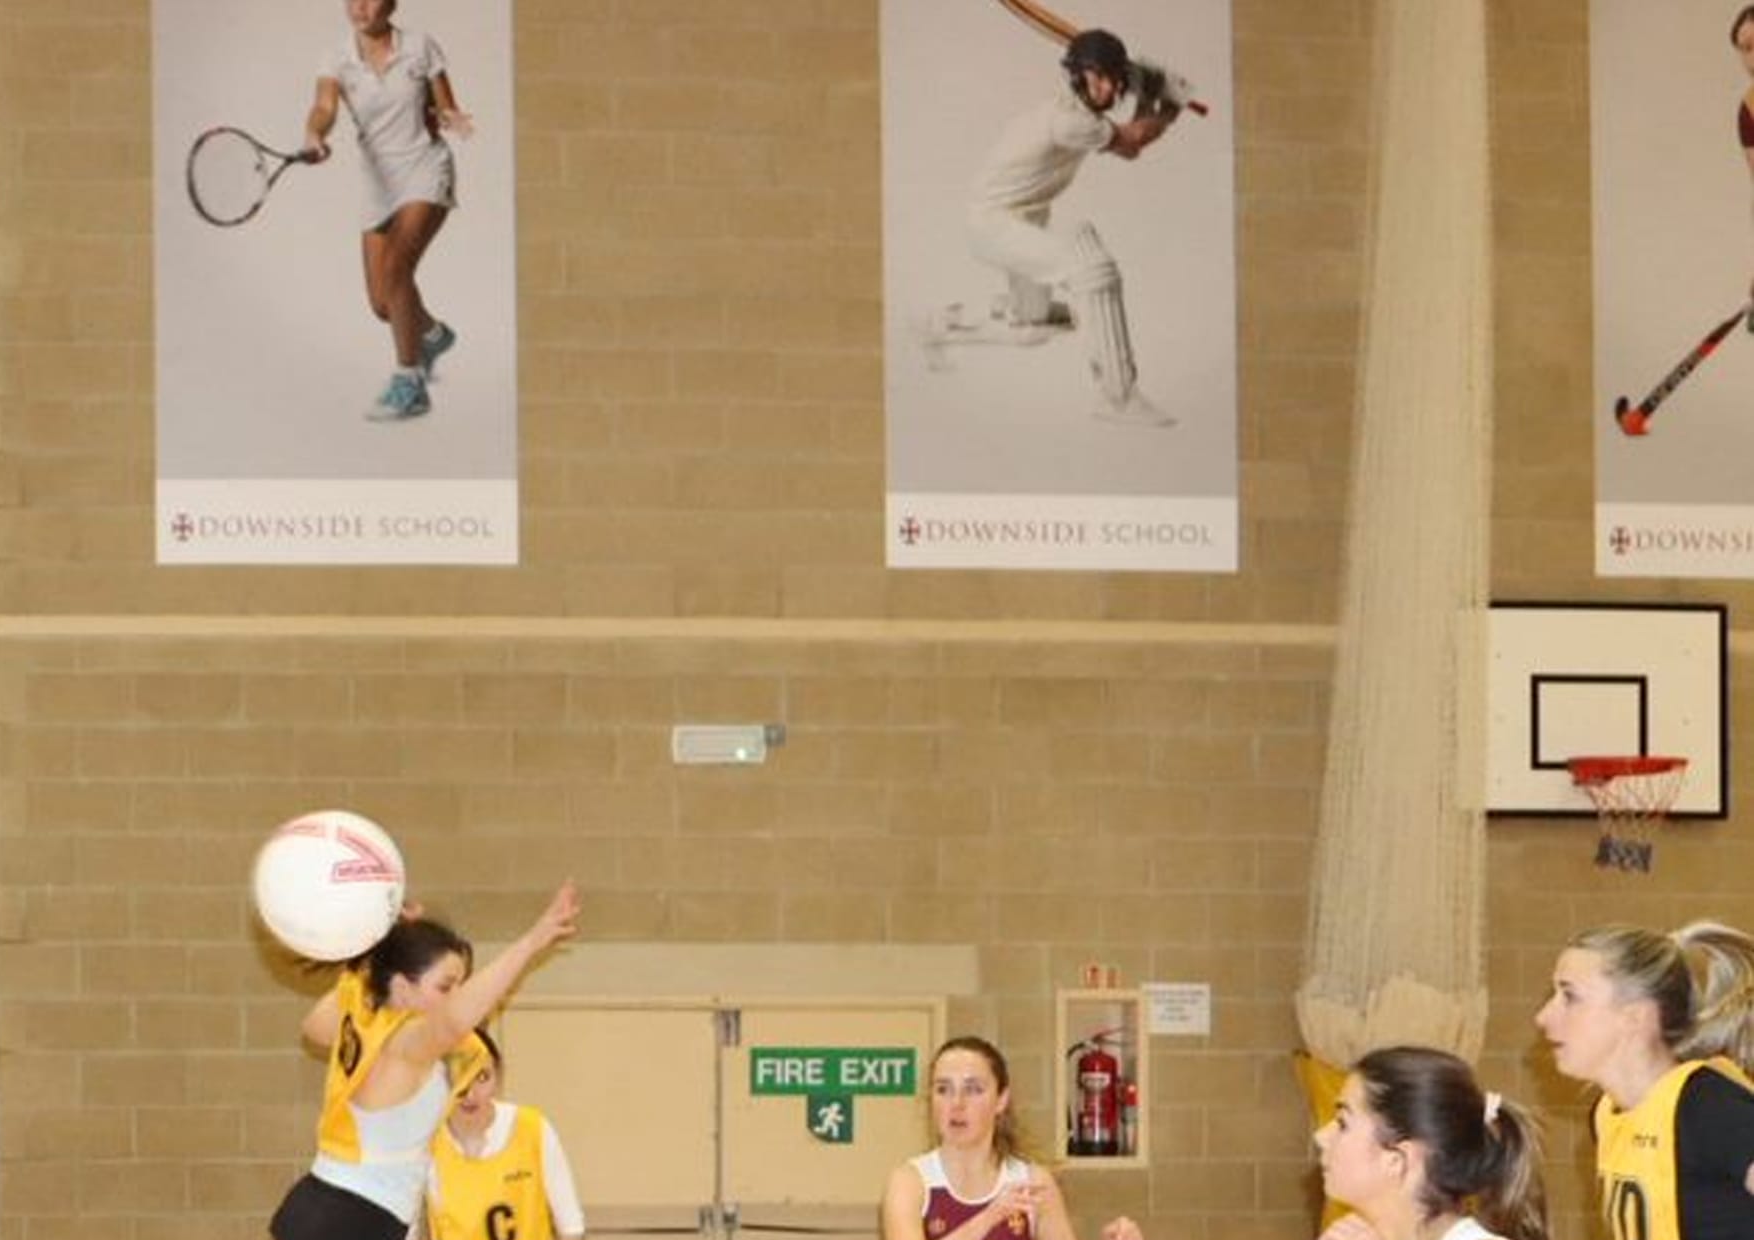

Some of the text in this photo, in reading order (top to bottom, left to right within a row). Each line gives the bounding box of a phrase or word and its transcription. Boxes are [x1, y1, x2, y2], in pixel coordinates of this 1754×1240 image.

[198, 514, 496, 540] DOWNSIDE SCHOOL
[926, 519, 1215, 548] DOWNSIDE SCHOOL
[755, 1056, 910, 1086] FIRE EXIT
